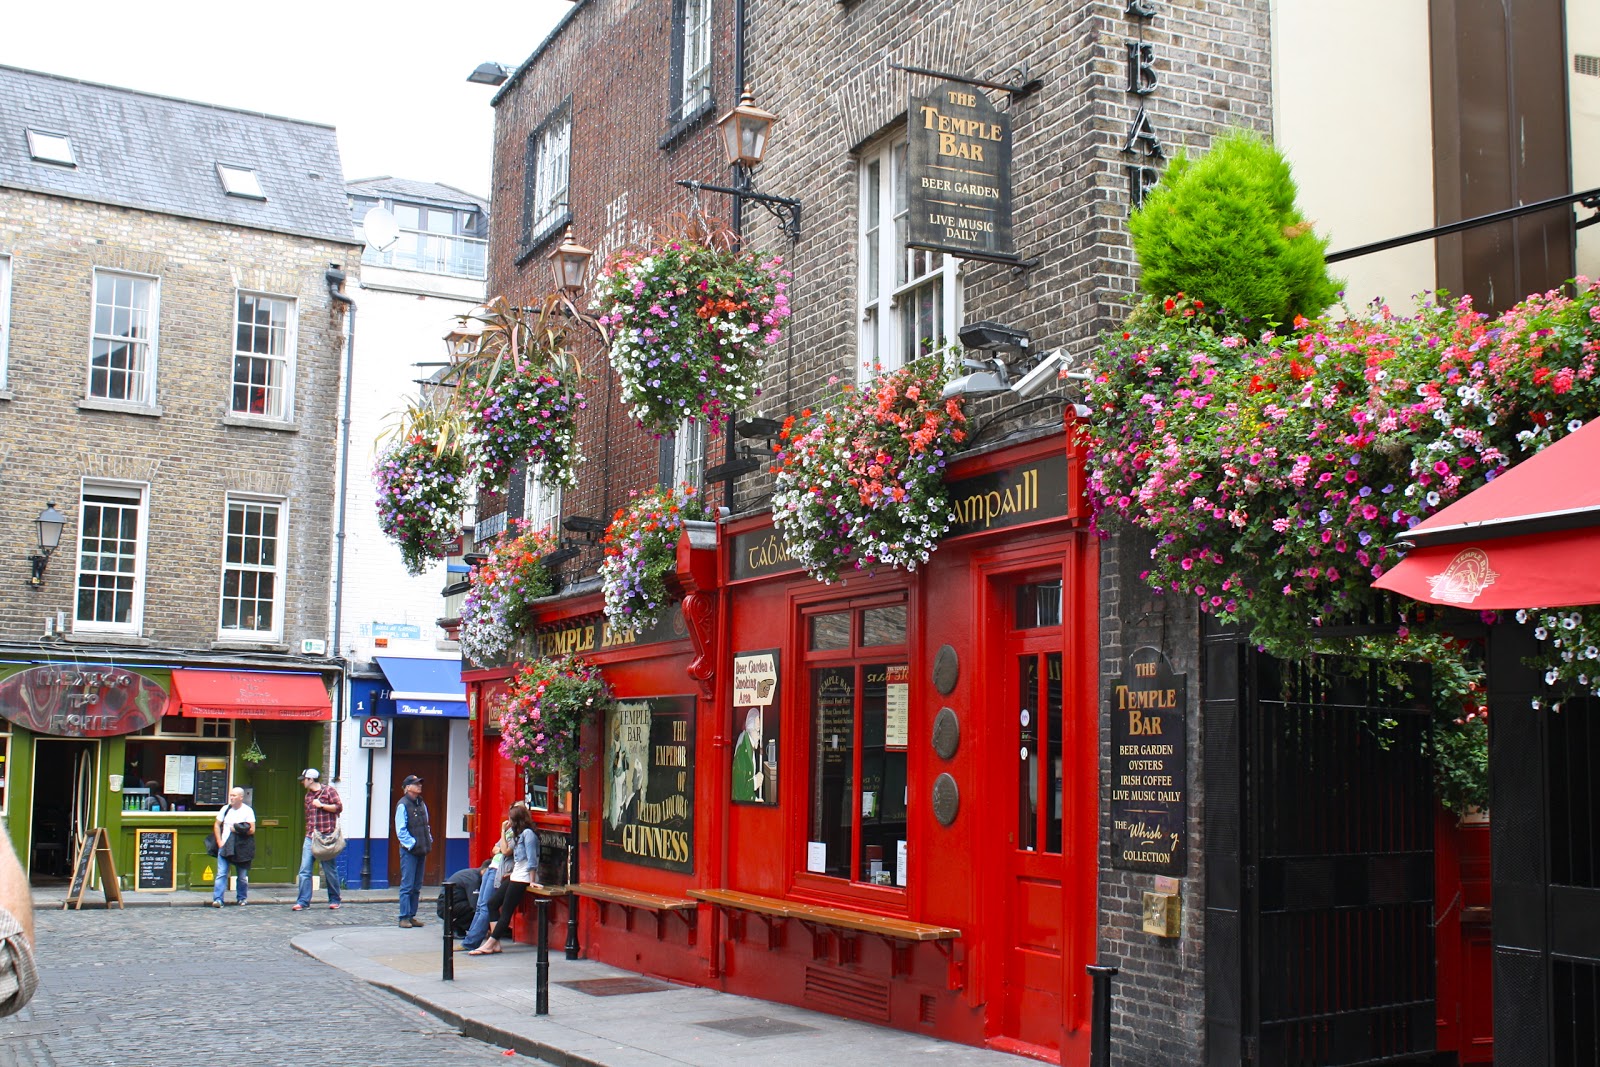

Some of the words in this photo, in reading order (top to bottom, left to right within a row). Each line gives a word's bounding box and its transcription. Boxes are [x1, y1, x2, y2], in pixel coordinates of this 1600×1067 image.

[948, 91, 976, 108] THE
[920, 105, 1003, 142] TEMPLE
[938, 132, 984, 162] BAR
[921, 177, 951, 191] BEER
[954, 182, 1000, 199] GARDEN
[606, 191, 628, 227] THE
[930, 213, 955, 227] LIVE
[958, 218, 994, 232] MUSIC
[946, 227, 978, 242] DAILY
[953, 468, 1038, 527] ampaill
[1455, 551, 1482, 563] TEMPLE
[537, 625, 594, 657] TEMPLE
[735, 661, 748, 675] Beer
[749, 659, 768, 674] Garden
[1135, 663, 1156, 677] THE
[735, 676, 757, 691] Smoking
[357, 701, 364, 710] 1
[739, 691, 752, 705] Area
[1115, 685, 1176, 710] TEMPLE
[619, 709, 649, 725] TEMPLE
[1129, 711, 1162, 735] BAR
[627, 727, 642, 743] BAR
[673, 721, 687, 742] THE
[655, 746, 687, 767] EMPEROR
[1119, 745, 1139, 755] BEER
[1141, 745, 1173, 755] GARDEN
[1128, 760, 1163, 771] OYSTERS
[677, 772, 687, 792] OF
[1120, 775, 1141, 786] IRISH
[1142, 775, 1172, 786] COFFEE
[1112, 790, 1130, 801] LIVE
[1131, 791, 1156, 801] MUSIC
[1157, 791, 1181, 802] DAILY
[637, 799, 661, 824] MALTED
[1114, 820, 1127, 830] THE
[622, 824, 689, 863] GUINNESS
[1123, 850, 1170, 863] COLLECTION
